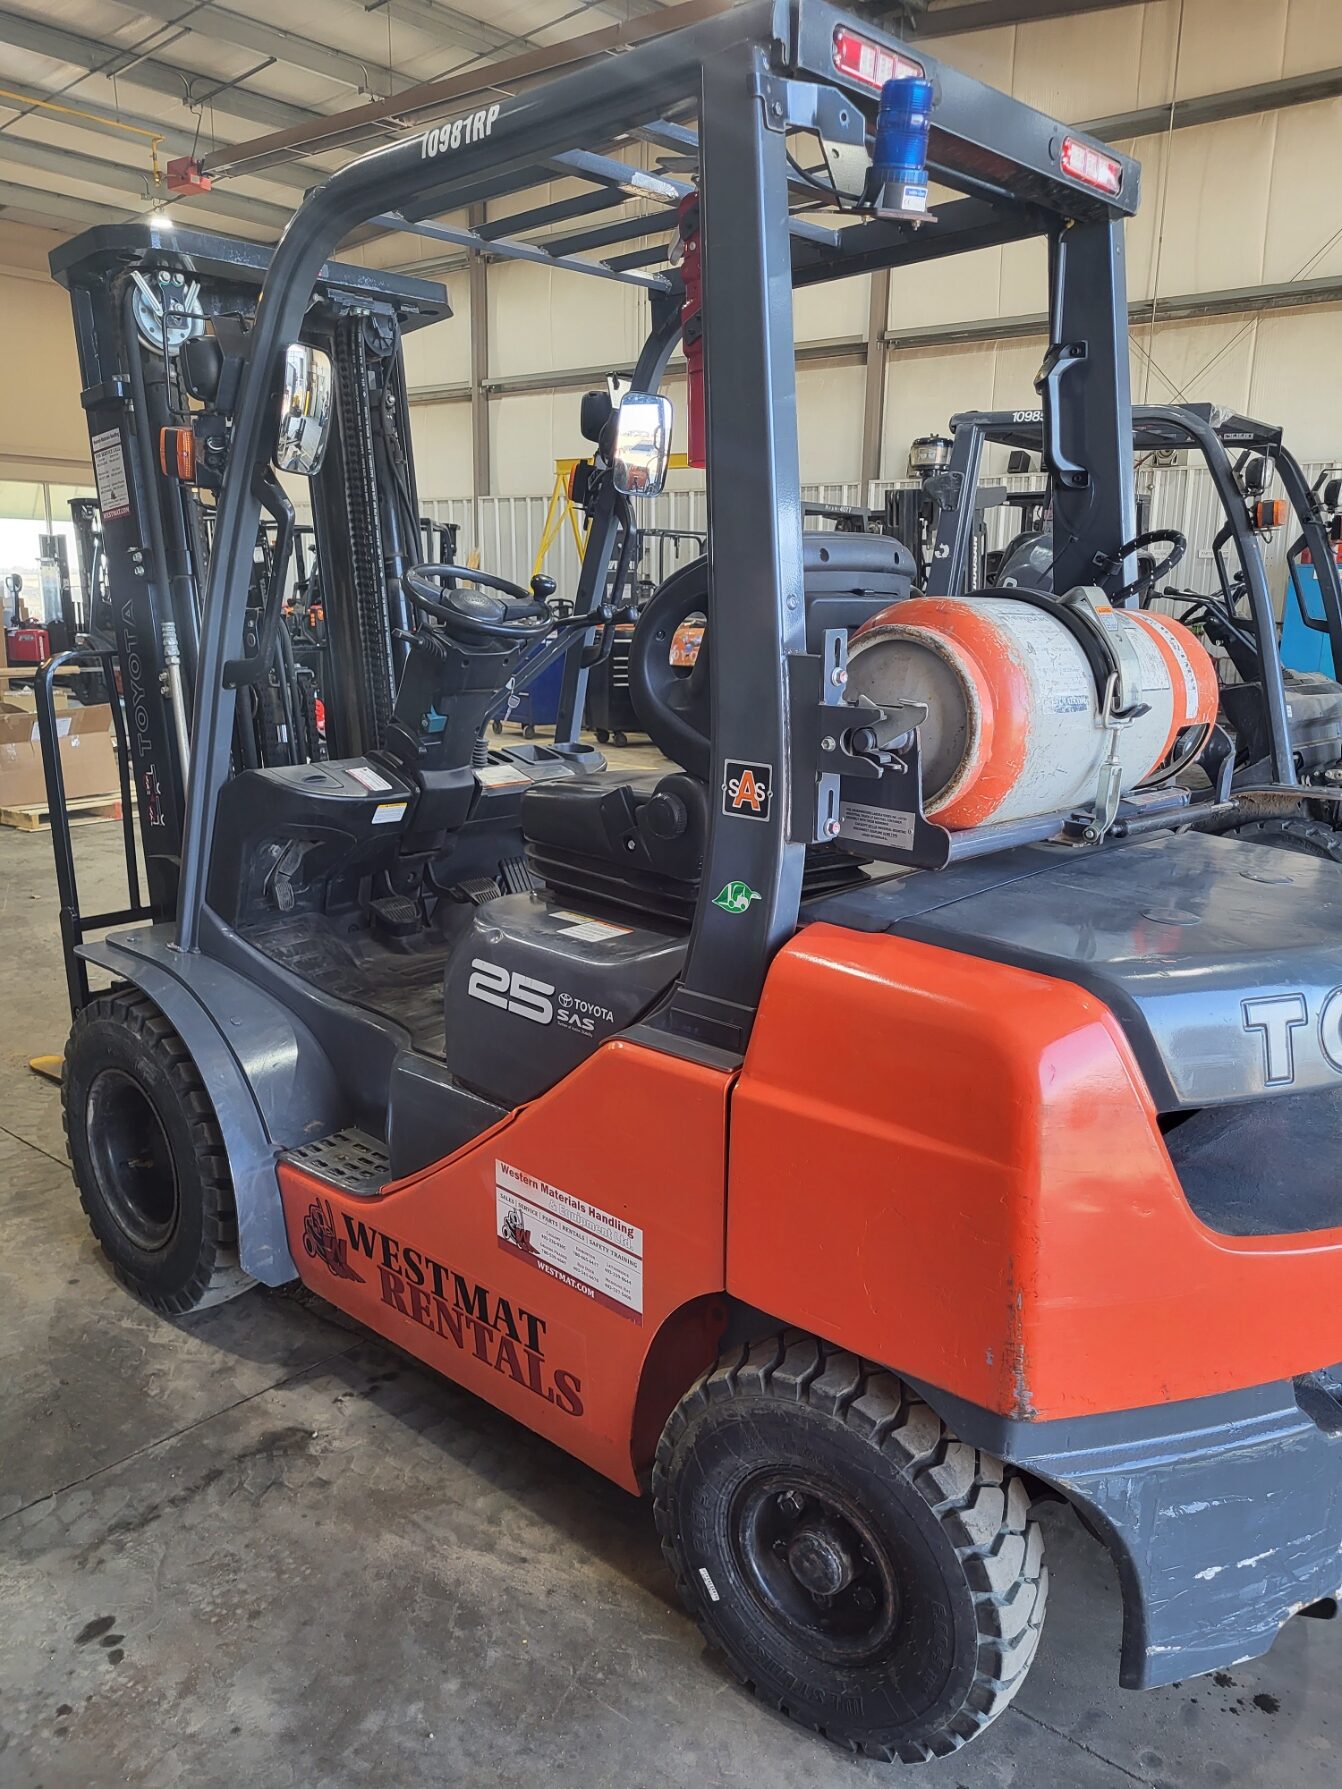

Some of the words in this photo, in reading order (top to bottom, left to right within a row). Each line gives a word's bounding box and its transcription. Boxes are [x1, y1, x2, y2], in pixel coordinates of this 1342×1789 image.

[421, 105, 500, 159] 10981RP
[121, 599, 152, 758] TOYOTA
[468, 958, 556, 1025] 25
[557, 1009, 595, 1031] SAS
[574, 998, 615, 1023] TOYOTA
[500, 1163, 538, 1190] Western
[541, 1182, 586, 1213] Materials
[589, 1206, 634, 1240] Handling
[341, 1212, 547, 1357] WESTMAT
[537, 1260, 595, 1299] WESTMAT.COM
[376, 1264, 584, 1417] RENTALS
